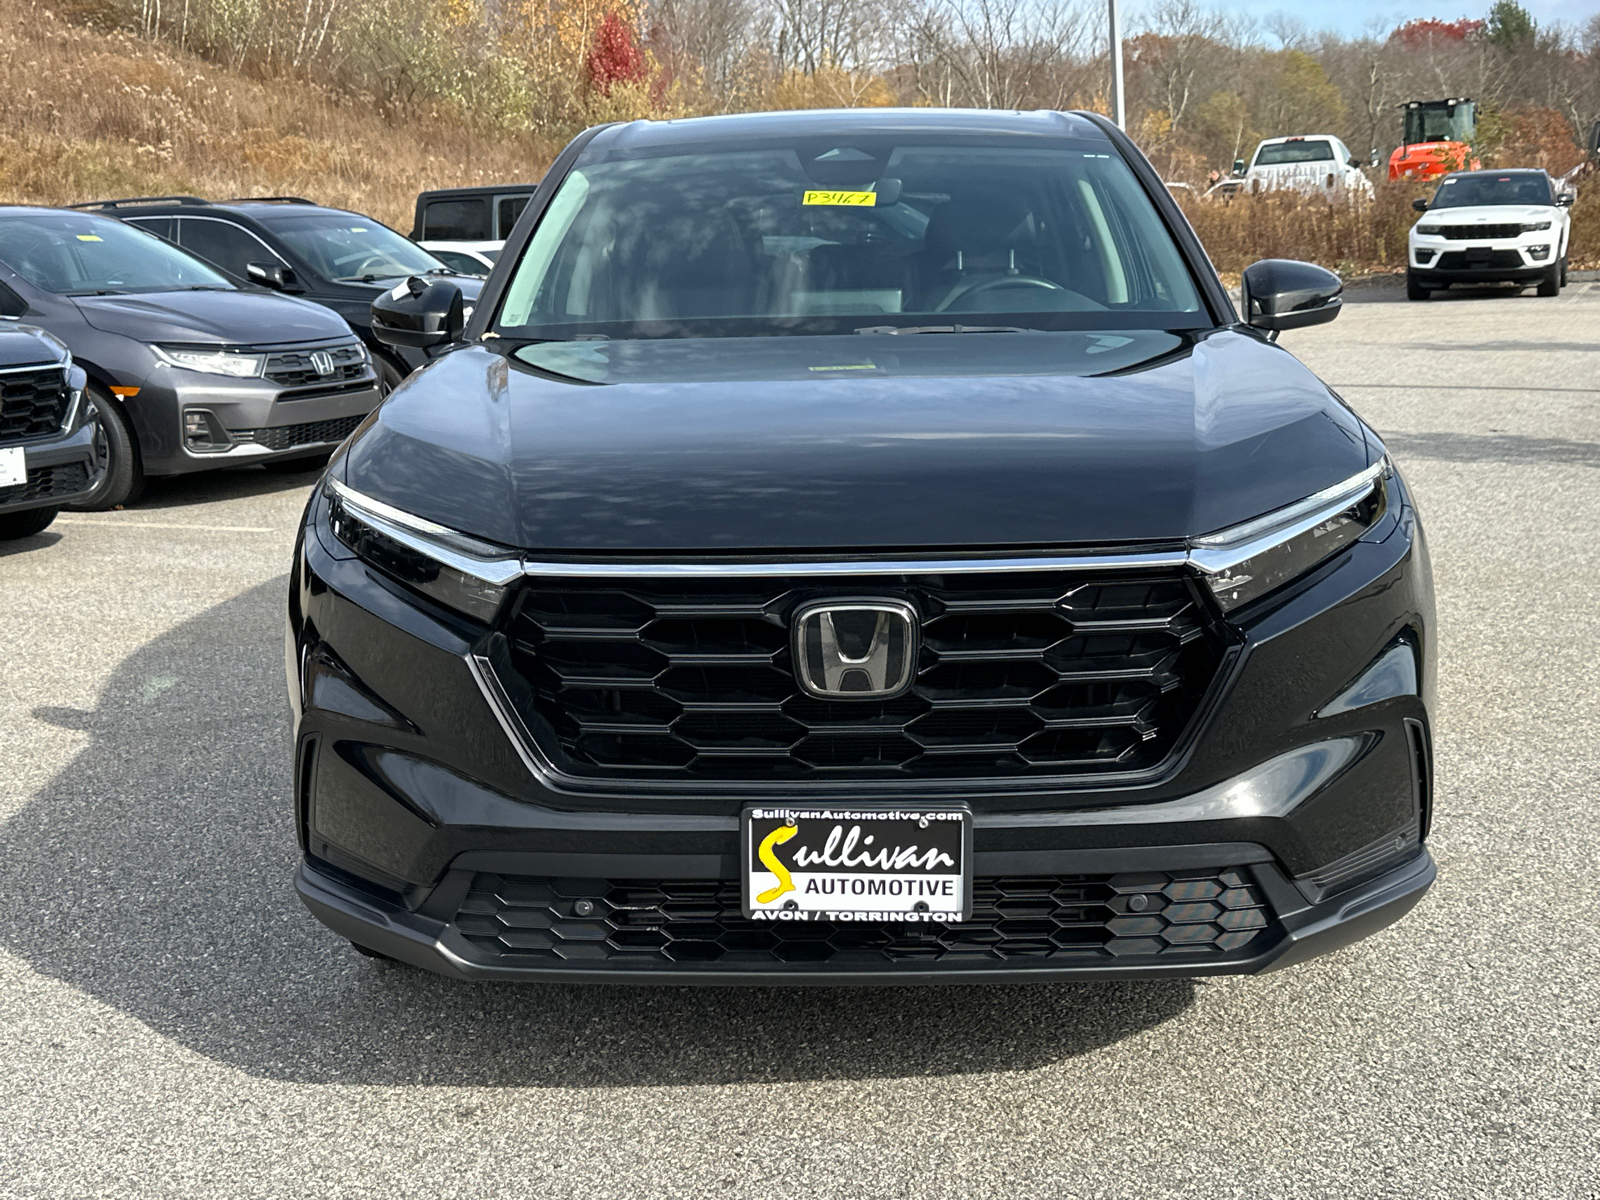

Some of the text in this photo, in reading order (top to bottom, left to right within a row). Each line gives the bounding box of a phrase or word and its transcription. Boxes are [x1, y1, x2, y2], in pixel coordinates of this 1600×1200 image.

[752, 809, 963, 821] SullivanAutomotive.com
[757, 825, 955, 904] Sullivan
[805, 879, 954, 896] AUTOMOTIVE
[751, 911, 808, 921] AVON
[827, 911, 963, 922] TORRINGTON
